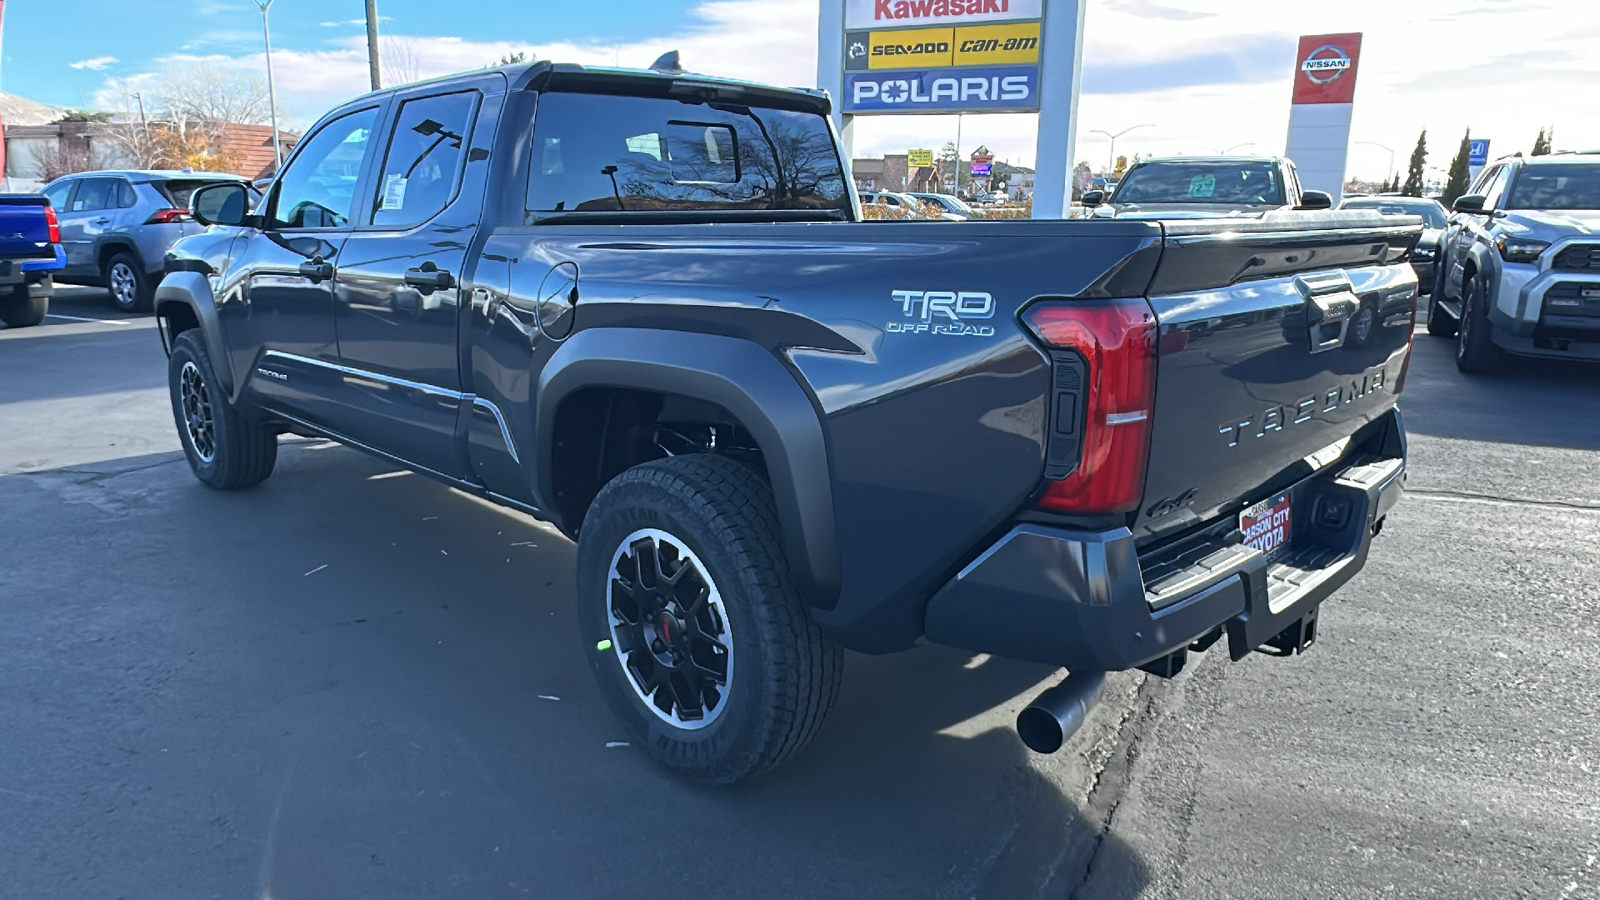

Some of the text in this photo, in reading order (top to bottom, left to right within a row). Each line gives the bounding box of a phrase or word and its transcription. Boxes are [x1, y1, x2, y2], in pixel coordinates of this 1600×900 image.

[874, 0, 1009, 20] Kawasaki
[1306, 60, 1346, 69] NISSAN
[853, 76, 1029, 104] POLARIS
[891, 289, 992, 321] TRD
[886, 322, 995, 336] OFF ROAD
[1219, 368, 1385, 448] TACOMA
[1273, 507, 1290, 527] CITY
